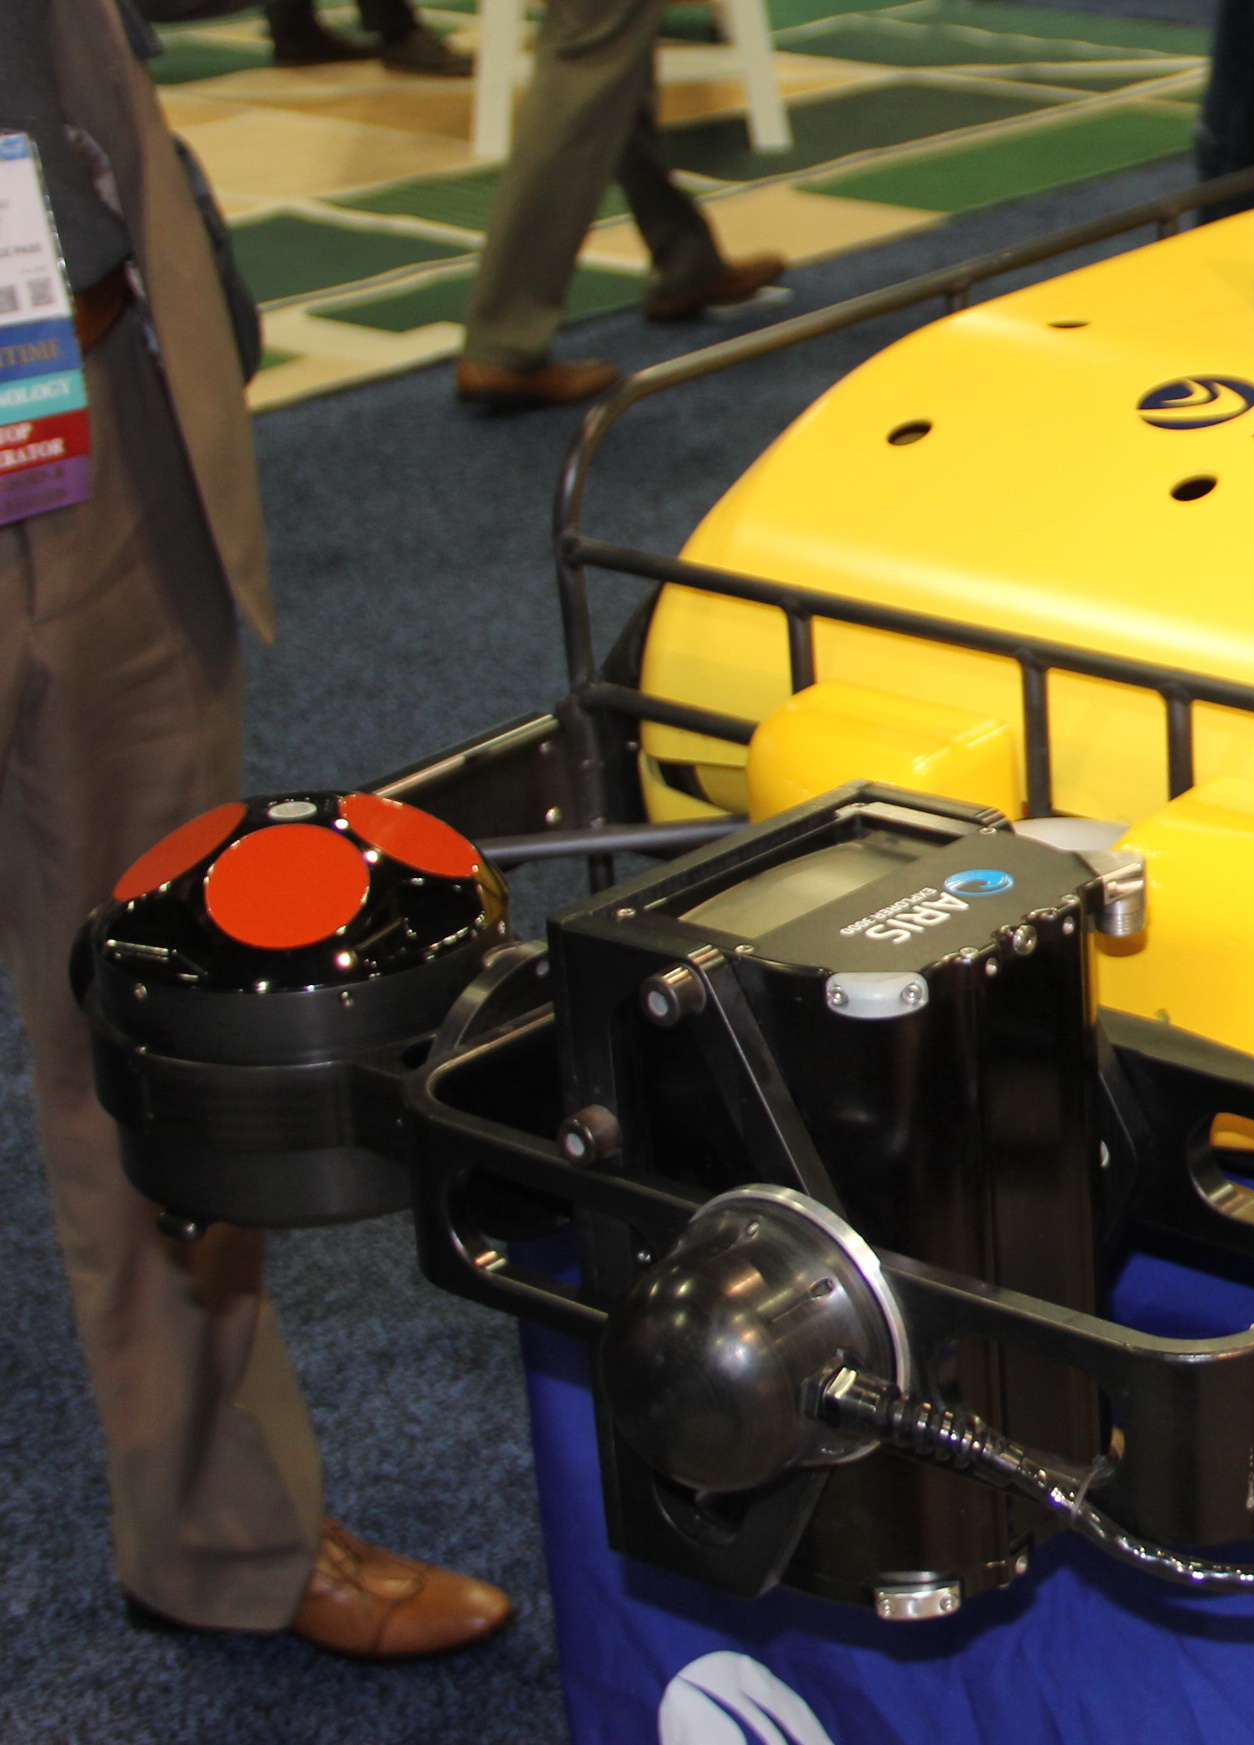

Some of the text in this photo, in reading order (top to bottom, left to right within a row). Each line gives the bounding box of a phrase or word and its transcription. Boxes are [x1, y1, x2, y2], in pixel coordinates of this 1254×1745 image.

[839, 886, 938, 937] EXPLORER 3000
[865, 890, 968, 945] ARIS
